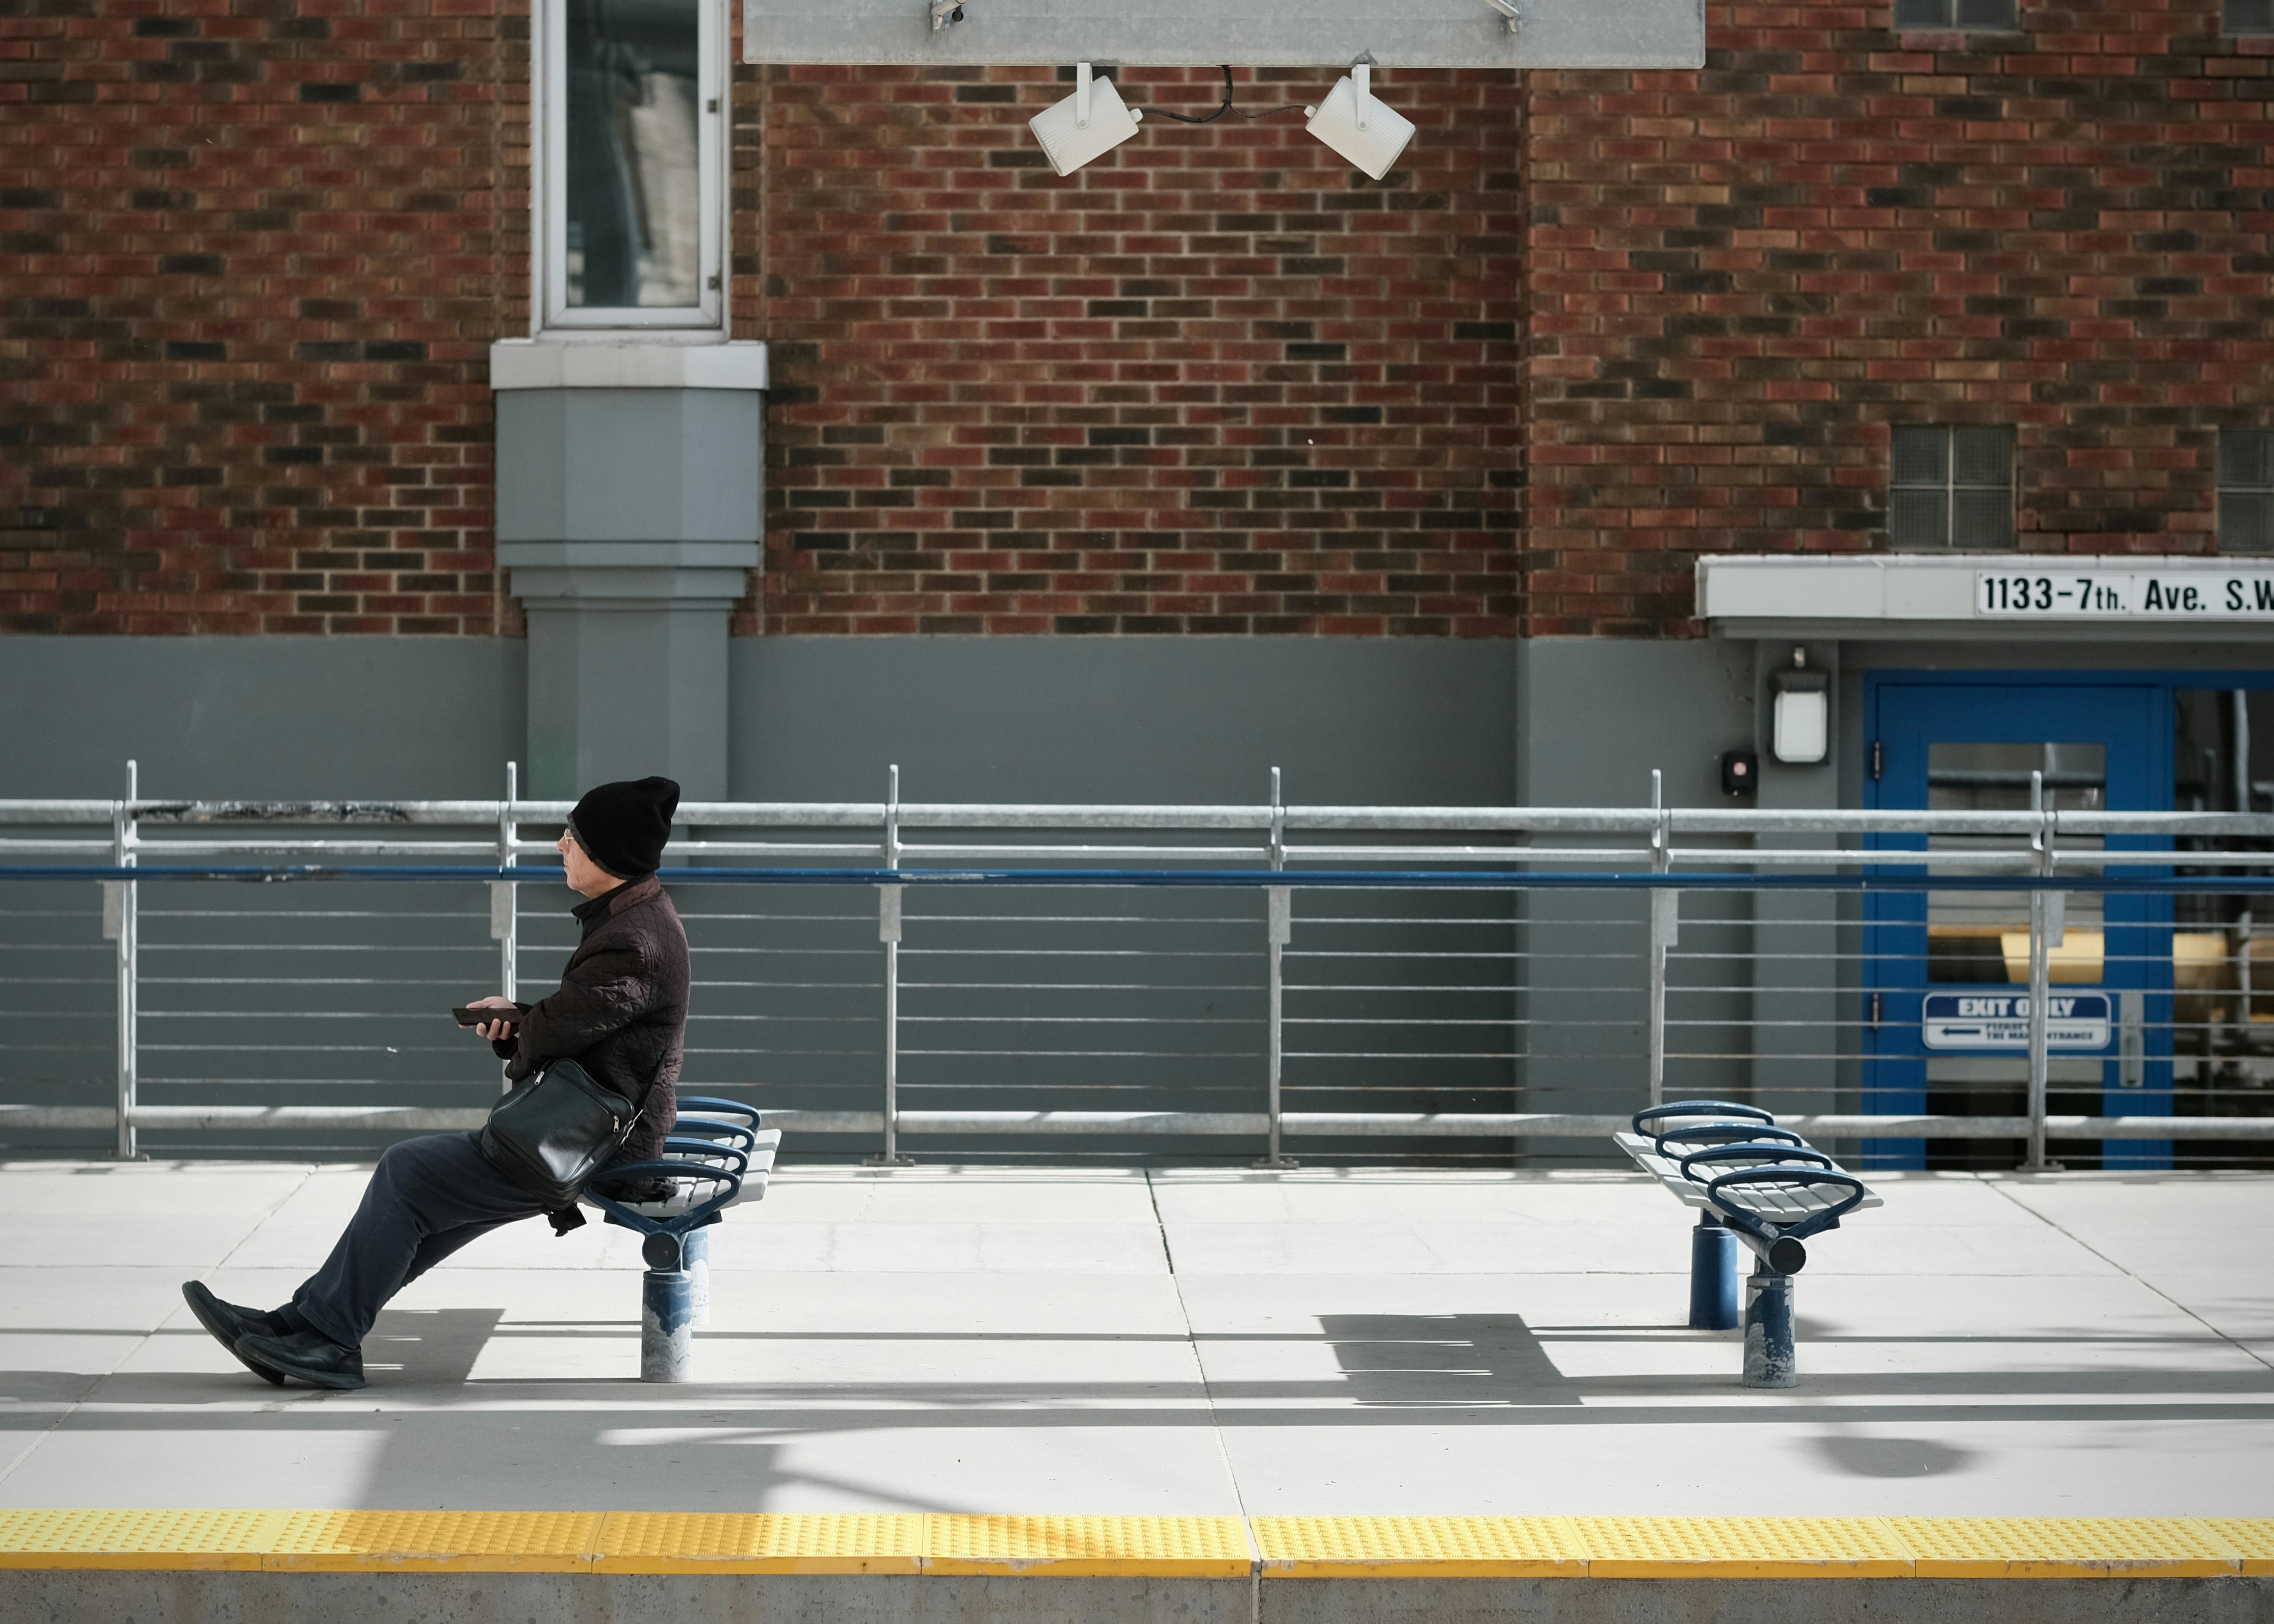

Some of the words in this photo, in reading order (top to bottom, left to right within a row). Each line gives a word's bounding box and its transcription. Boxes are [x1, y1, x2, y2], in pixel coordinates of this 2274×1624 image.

[1984, 578, 2126, 610] 1133-7th.
[2144, 580, 2206, 610] Ave.
[1958, 998, 2011, 1016] EXIT
[2015, 998, 2076, 1016] OLY
